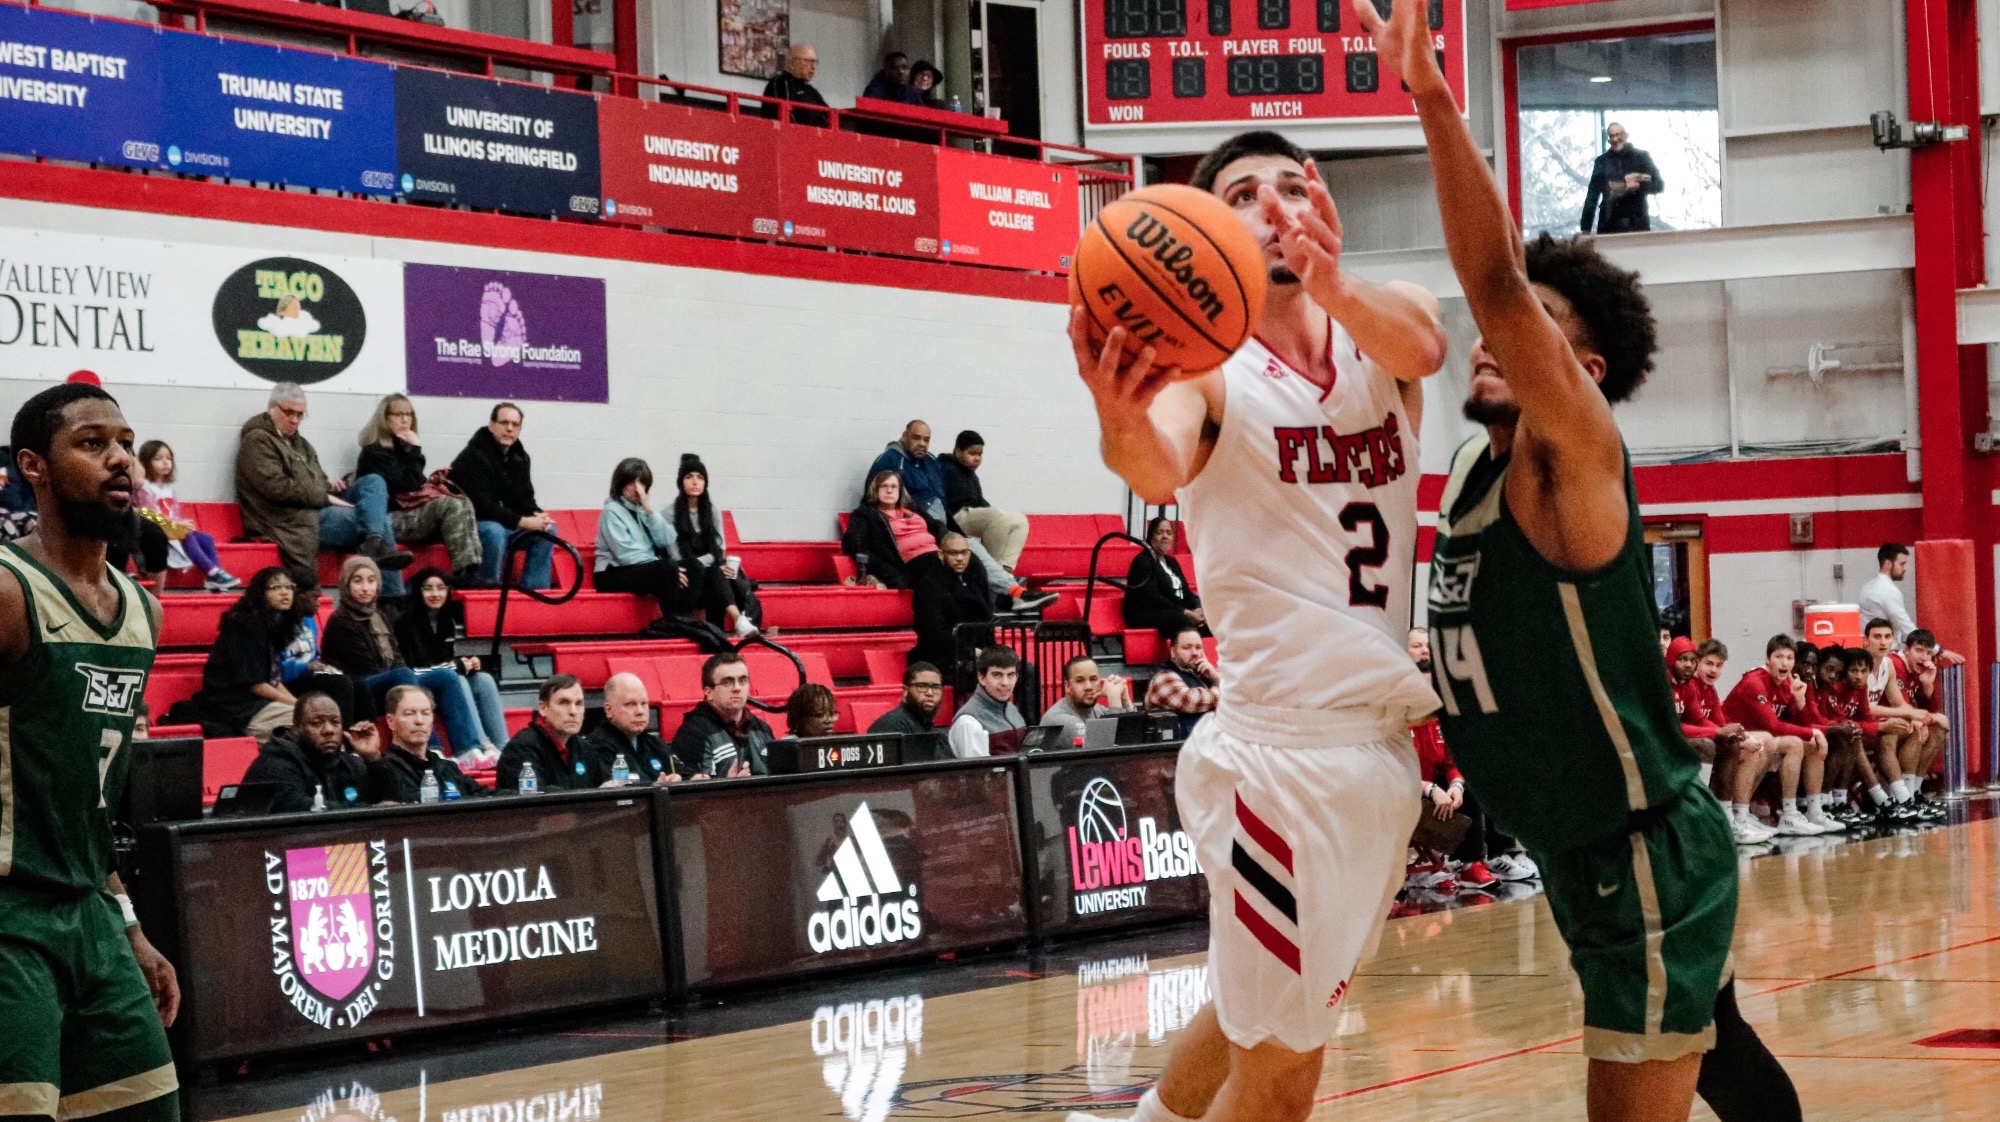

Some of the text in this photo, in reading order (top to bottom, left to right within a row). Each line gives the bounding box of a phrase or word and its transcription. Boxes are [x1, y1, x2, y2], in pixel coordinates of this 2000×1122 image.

[1103, 42, 1151, 59] FOULS
[1168, 40, 1209, 57] T.O.L.
[1222, 37, 1326, 56] PLAYER FOUL
[1341, 36, 1377, 52] T.O.L
[0, 41, 127, 80] WEST BAPTIST
[218, 72, 344, 111] TRUMAN STATE
[234, 107, 332, 140] UNIVERSITY
[446, 106, 554, 139] UNIVERSITY OF
[1108, 105, 1144, 121] WON
[1251, 101, 1303, 117] MATCH
[184, 151, 222, 167] DIVISION
[424, 133, 578, 172] ILLINOIS SPRINGFIELD
[644, 135, 740, 165] UNIVERSITY OF
[416, 179, 449, 193] DIVISION
[648, 164, 738, 193] INDIANAPOLIS
[817, 160, 903, 188] UNIVERSITY OF
[617, 203, 647, 217] DIVISION
[806, 185, 916, 216] MISSOURI-ST. LOUIS
[968, 181, 1052, 209] WILLIAM JEWELL
[794, 224, 821, 237] DIVISION
[988, 210, 1034, 231] COLLEGE
[0, 258, 152, 300] ALLEY VIEW
[1126, 212, 1225, 325] Wilson
[255, 269, 325, 303] TACO
[0, 293, 154, 352] DENTAL
[237, 329, 344, 364] HEAVEN
[434, 336, 457, 356] The
[458, 338, 482, 357] Rae
[483, 341, 521, 363] Strong
[522, 342, 581, 363] Foundation
[1338, 502, 1390, 611] 2
[1428, 624, 1500, 716] 14
[88, 669, 141, 709] S&T
[97, 728, 123, 809] 7
[290, 877, 329, 901] 1870
[427, 864, 557, 913] LOYOLA
[1074, 886, 1147, 915] UNIVERSITY
[264, 839, 395, 1030] AD MAJOREM DEI GLORIAM
[808, 893, 921, 954] adidas
[433, 916, 598, 971] MEDICINE
